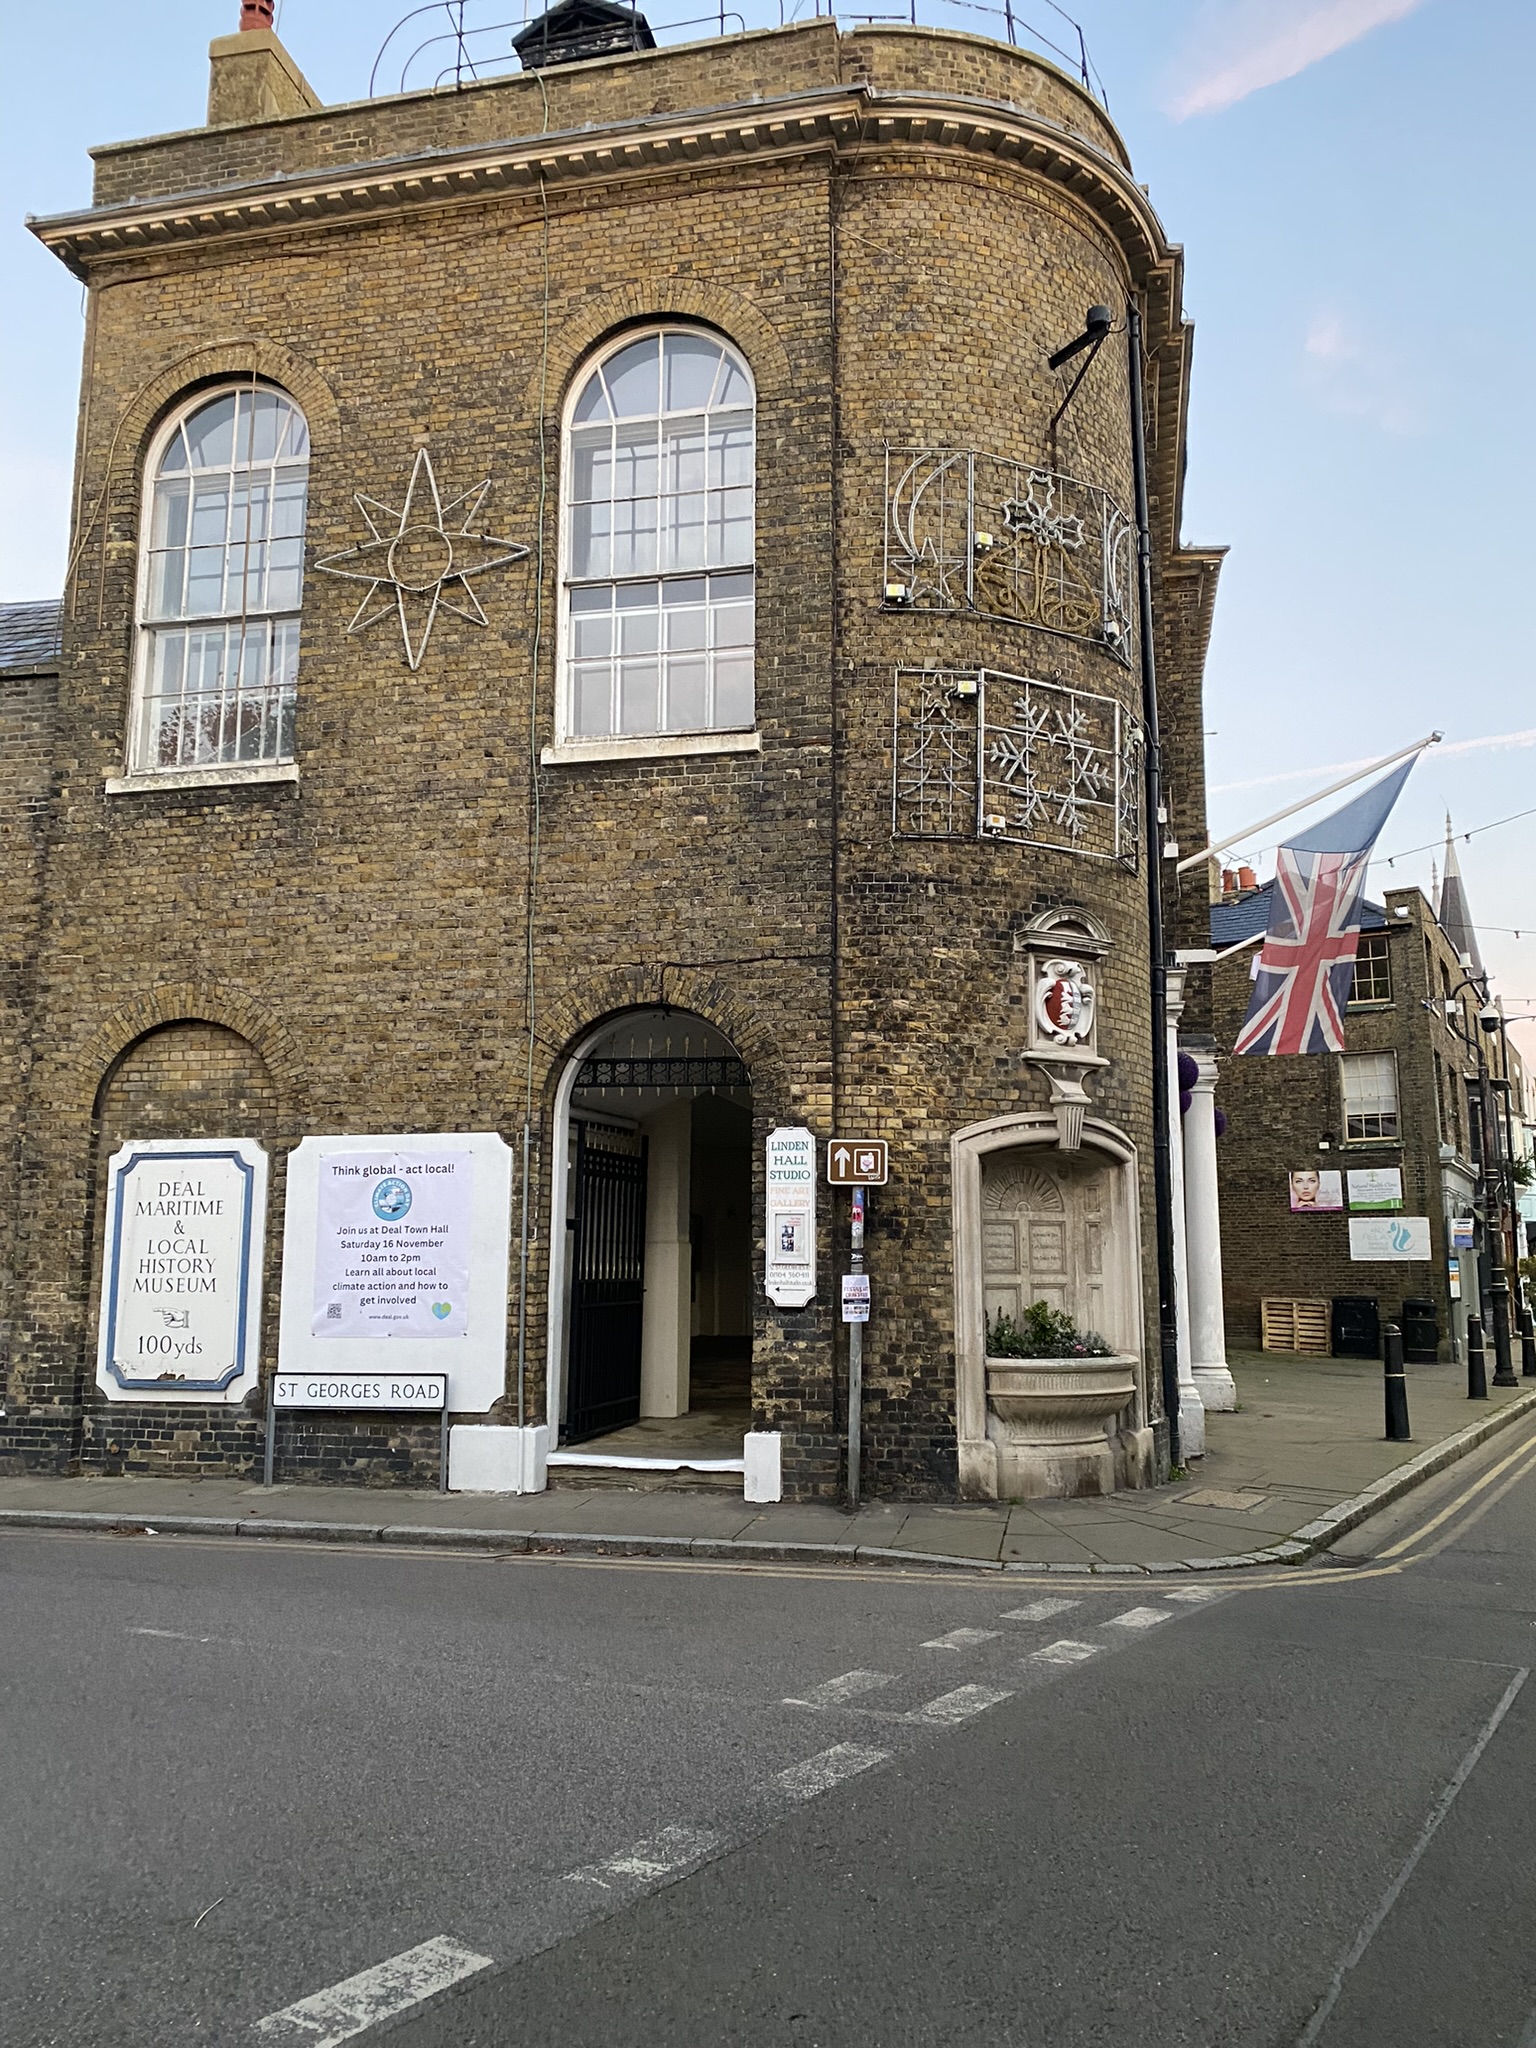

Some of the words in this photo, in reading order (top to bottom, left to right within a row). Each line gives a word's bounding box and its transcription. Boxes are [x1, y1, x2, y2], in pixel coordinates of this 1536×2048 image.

[771, 1141, 809, 1151] LINDEN
[774, 1156, 808, 1165] HALL
[332, 1166, 360, 1176] Think
[362, 1165, 396, 1178] global
[406, 1166, 422, 1174] act
[426, 1164, 454, 1174] local!
[770, 1170, 811, 1180] STUDIO
[158, 1182, 206, 1197] DEAL
[388, 1180, 408, 1194] ACTION
[135, 1200, 224, 1216] MARITIME
[770, 1200, 811, 1208] GALLERY
[174, 1220, 185, 1235] &
[336, 1226, 356, 1235] Join
[381, 1226, 402, 1234] Deal
[404, 1225, 428, 1234] Town
[430, 1225, 449, 1233] Hall
[148, 1239, 209, 1254] LOCAL
[340, 1240, 380, 1250] Saturday
[382, 1240, 394, 1248] 16
[396, 1239, 444, 1248] November
[360, 1254, 387, 1262] 10am
[400, 1254, 421, 1264] 2pm
[139, 1258, 216, 1274] HISTORY
[372, 1268, 384, 1276] all
[386, 1268, 412, 1276] about
[414, 1267, 436, 1276] local
[133, 1277, 217, 1293] MUSEUM
[332, 1282, 366, 1290] climate
[367, 1282, 396, 1290] action
[398, 1282, 416, 1290] and
[418, 1282, 437, 1290] how
[360, 1296, 375, 1306] get
[377, 1296, 417, 1304] involved
[278, 1383, 298, 1397] ST
[307, 1383, 380, 1398] GEORGES
[391, 1384, 440, 1399] ROAD
